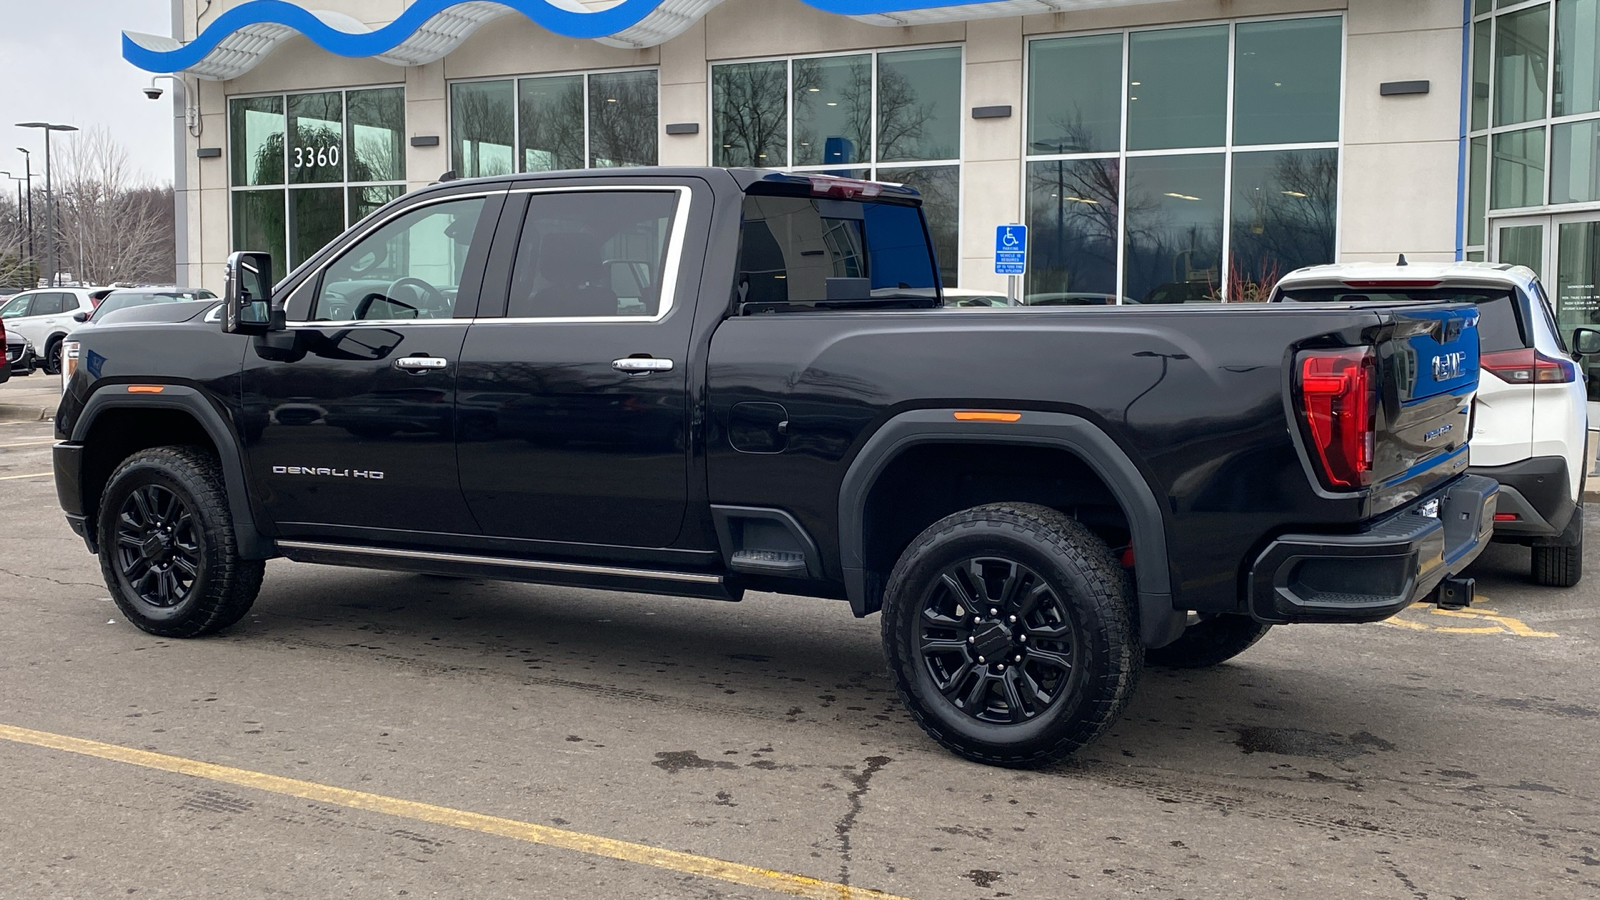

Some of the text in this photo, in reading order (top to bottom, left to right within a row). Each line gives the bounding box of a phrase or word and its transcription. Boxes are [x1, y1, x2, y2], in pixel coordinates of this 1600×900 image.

[294, 145, 339, 168] 3360
[1432, 351, 1466, 382] GMC
[272, 466, 384, 479] DENALI HD
